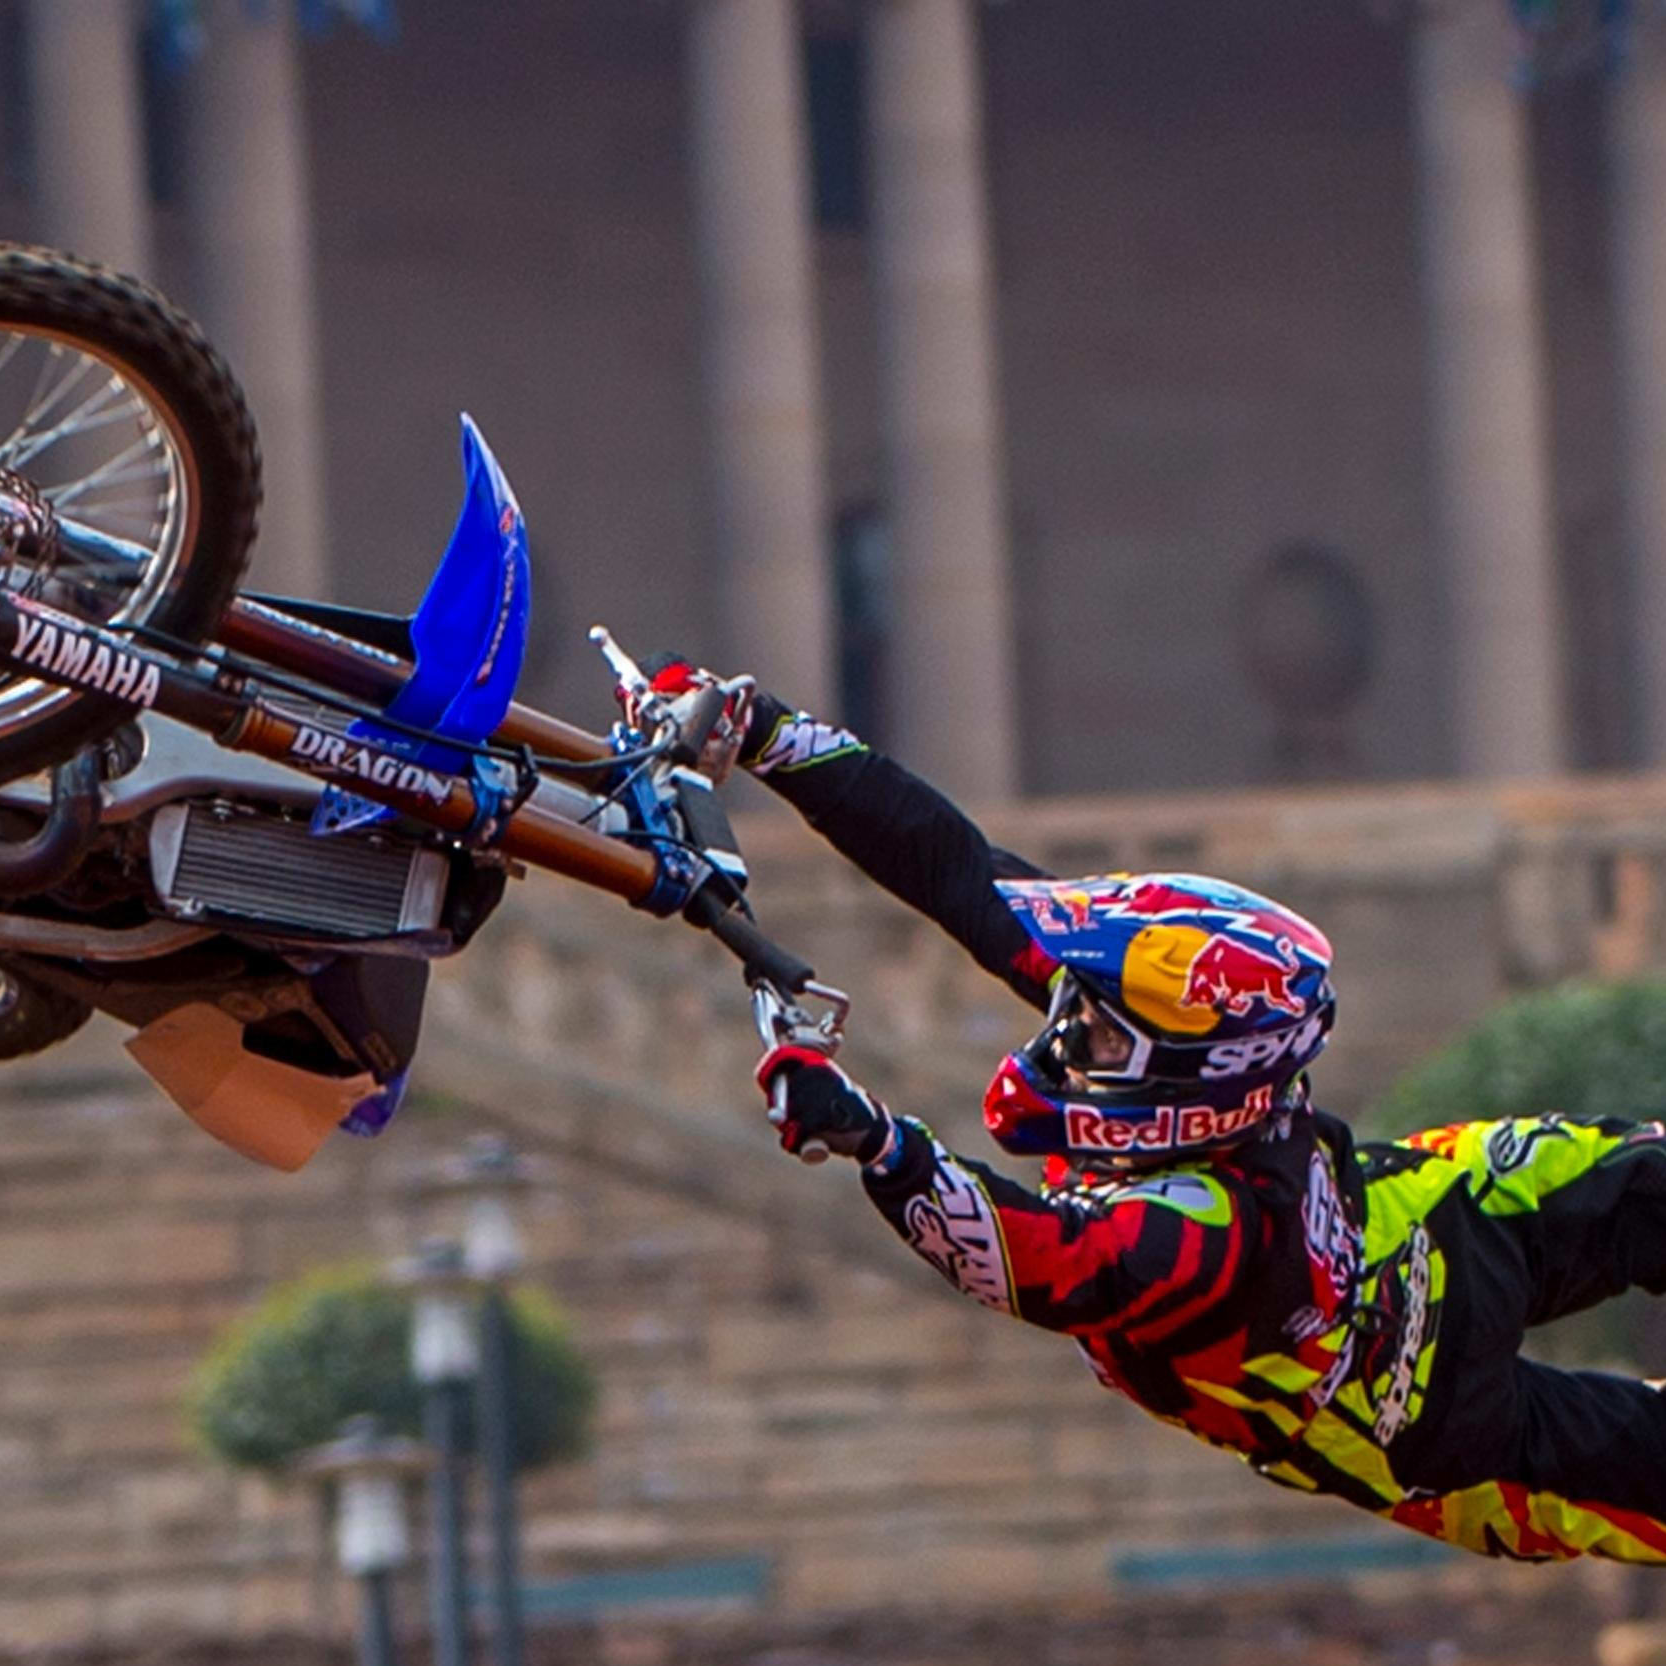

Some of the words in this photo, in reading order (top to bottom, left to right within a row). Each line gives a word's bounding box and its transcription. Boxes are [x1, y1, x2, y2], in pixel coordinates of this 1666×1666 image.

[11, 613, 161, 707] YAMAHA
[292, 725, 452, 804] DRAGON
[1064, 1103, 1173, 1149] Red
[1177, 1083, 1273, 1146] Bull
